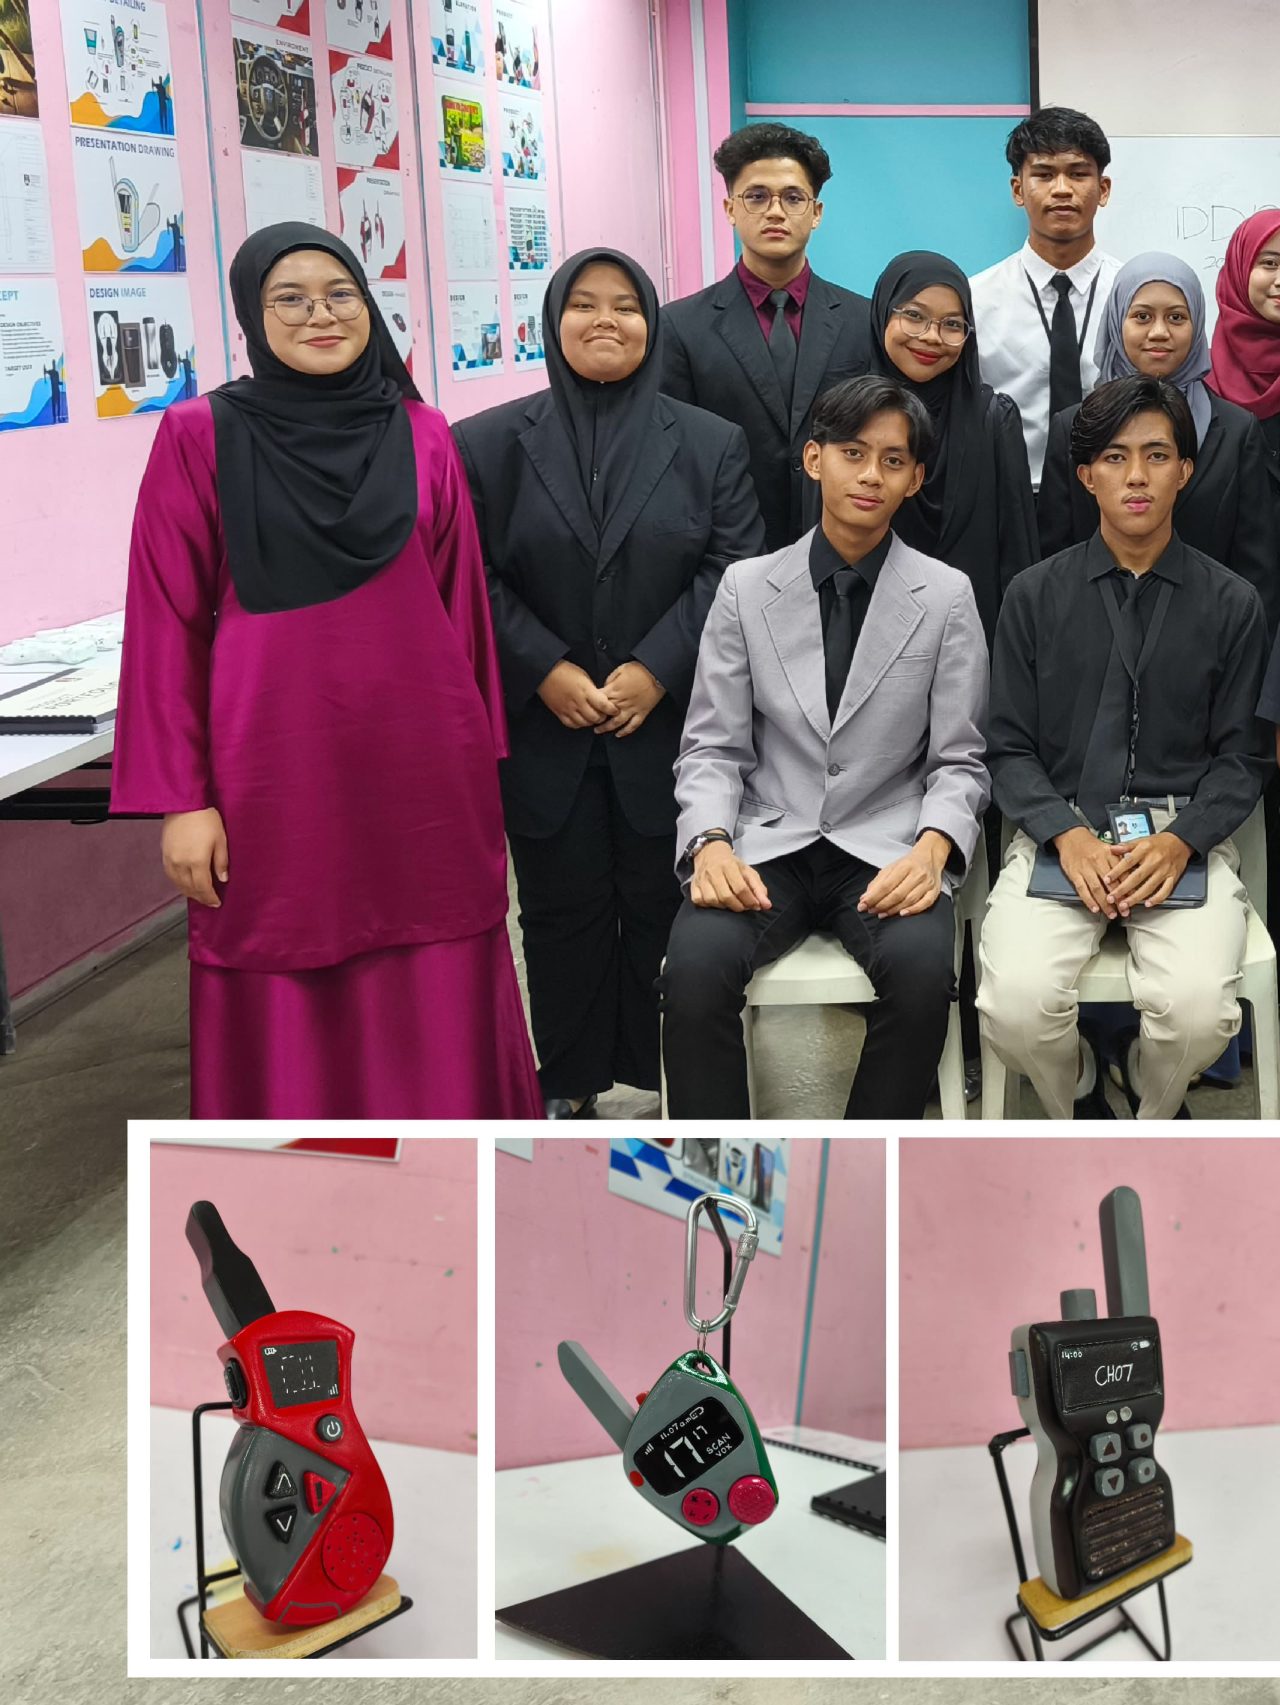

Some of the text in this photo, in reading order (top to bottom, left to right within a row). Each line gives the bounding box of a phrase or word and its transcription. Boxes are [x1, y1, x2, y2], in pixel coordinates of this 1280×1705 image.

[75, 136, 175, 158] PRESENTATION DRAWING
[0, 290, 19, 301] EPT
[89, 287, 147, 298] DESIGN IMAGE
[1061, 1351, 1083, 1359] 14:00
[1095, 1363, 1134, 1386] CH07
[706, 1432, 732, 1455] SCAN
[715, 1443, 733, 1457] VOX
